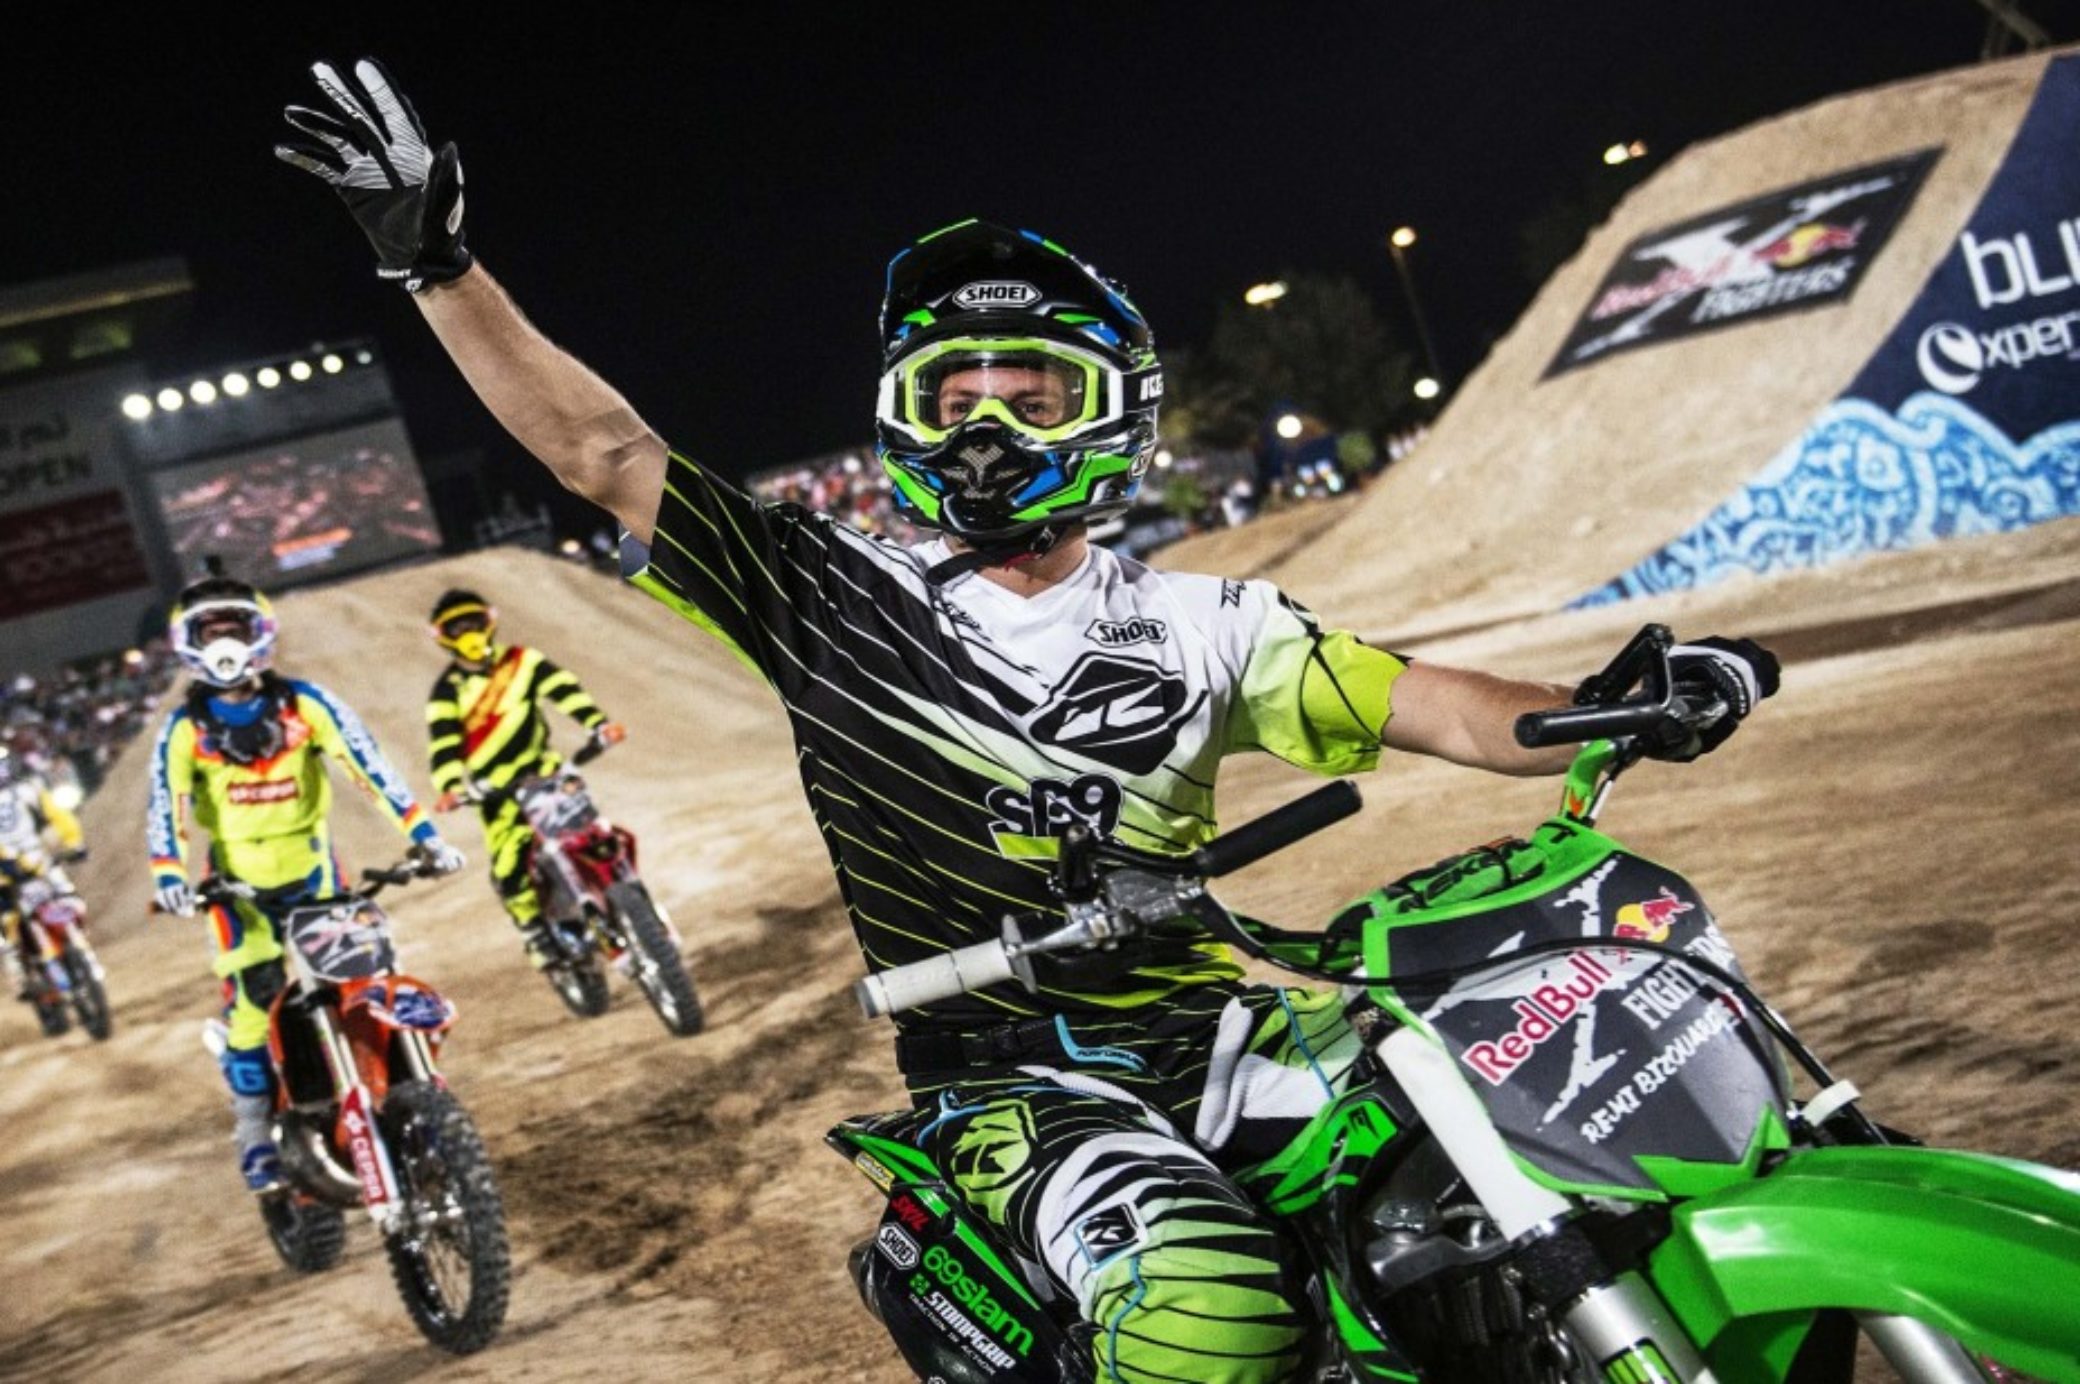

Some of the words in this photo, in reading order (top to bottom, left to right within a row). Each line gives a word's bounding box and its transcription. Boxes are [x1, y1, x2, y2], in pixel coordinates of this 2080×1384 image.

[965, 286, 1029, 302] SHOEI
[1580, 1085, 1642, 1144] REMI
[881, 1228, 914, 1264] SHOEI
[923, 1245, 1035, 1357] 69slam
[922, 1291, 1017, 1370] STOMPGRIP
[960, 1344, 997, 1377] ACTION
